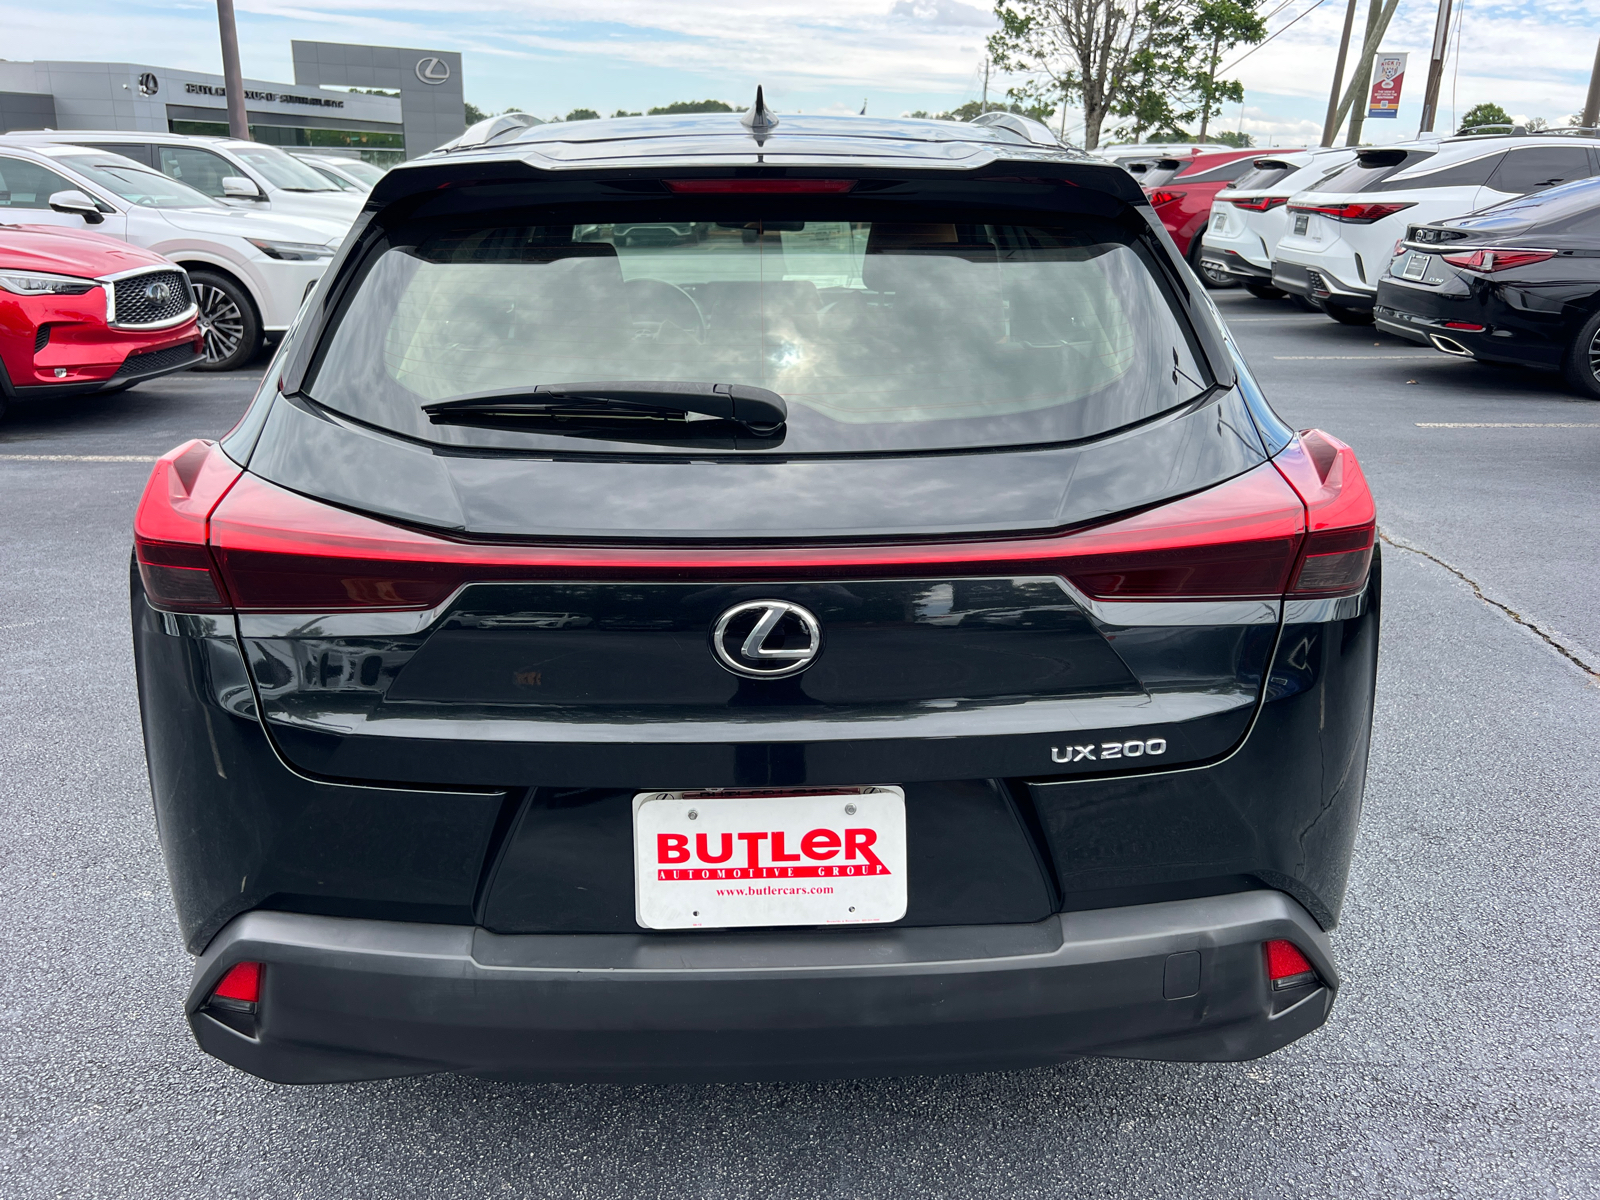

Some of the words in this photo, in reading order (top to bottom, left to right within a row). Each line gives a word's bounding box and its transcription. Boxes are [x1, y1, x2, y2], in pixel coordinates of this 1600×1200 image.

[1051, 744, 1097, 763] UX
[1100, 738, 1167, 759] 200
[658, 867, 794, 880] AUTOMOTIVE
[818, 864, 883, 877] GROUP
[716, 884, 835, 897] www.butlercars.com
